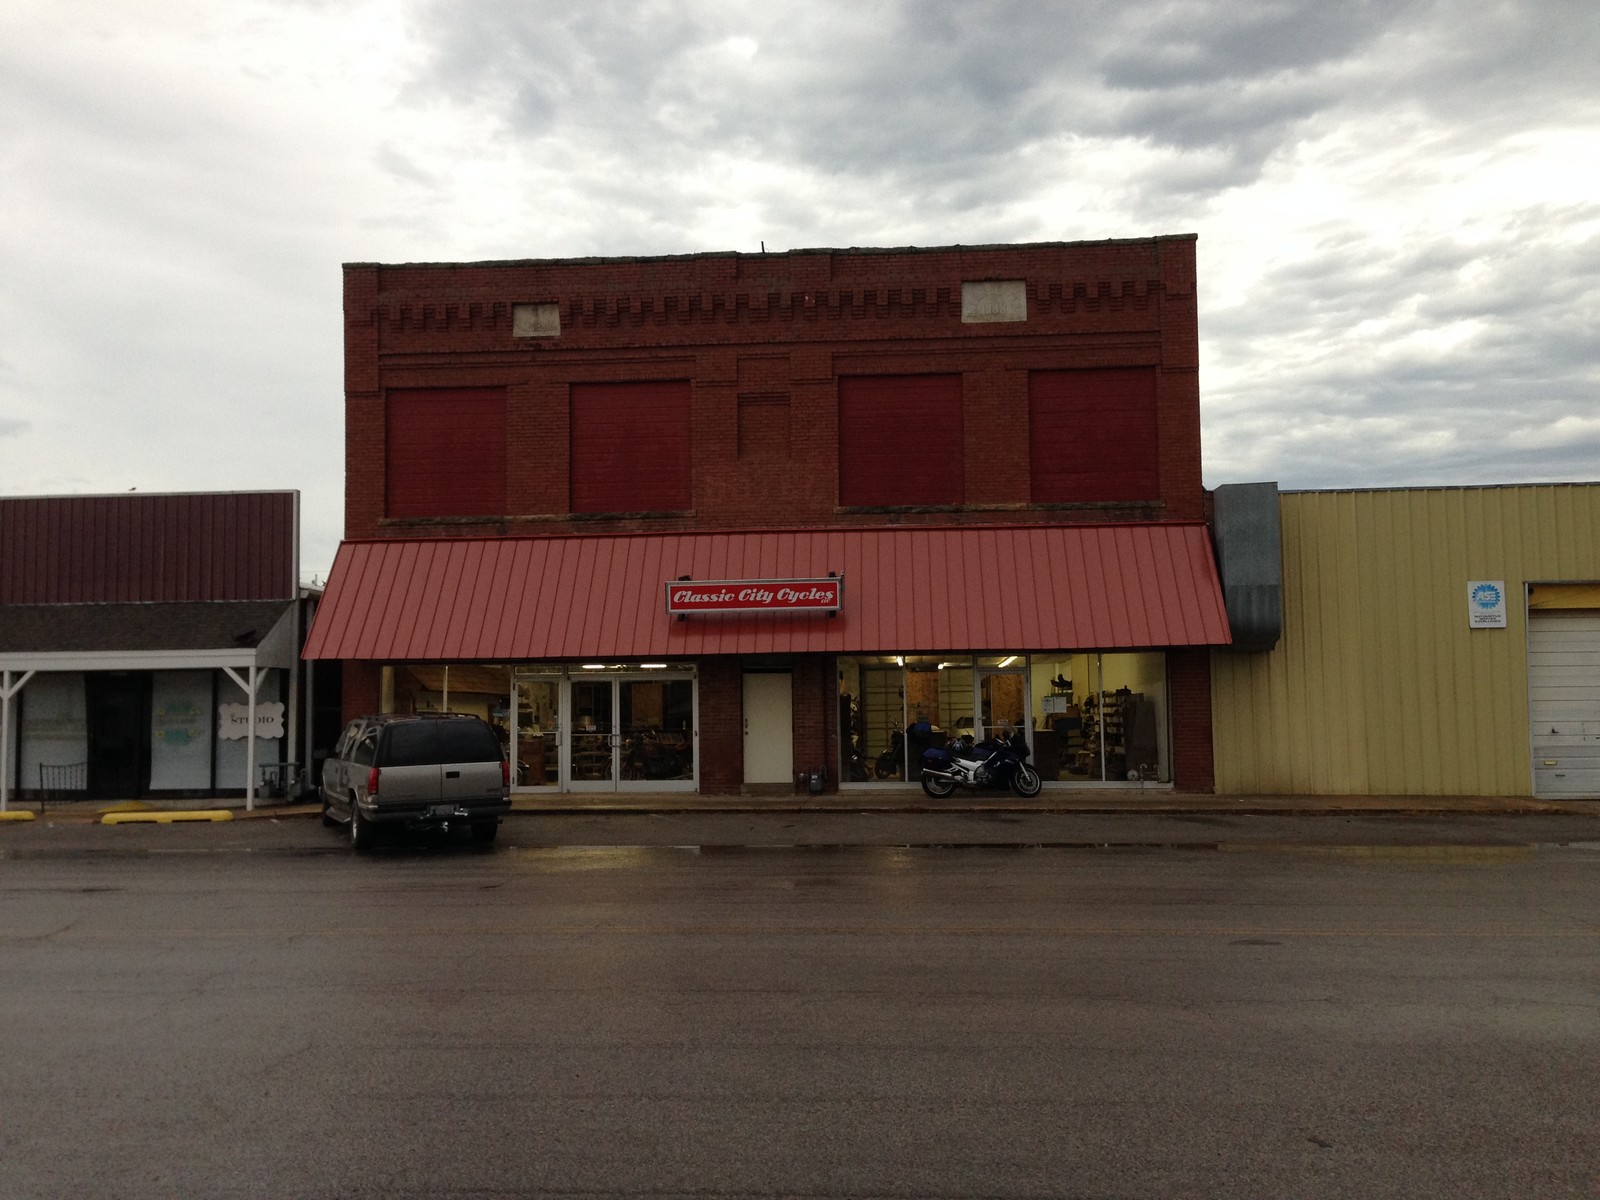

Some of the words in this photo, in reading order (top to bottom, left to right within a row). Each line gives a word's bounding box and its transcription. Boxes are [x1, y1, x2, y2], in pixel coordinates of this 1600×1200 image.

[673, 589, 735, 603] Classic
[738, 588, 775, 604] City
[777, 587, 834, 603] Cycles
